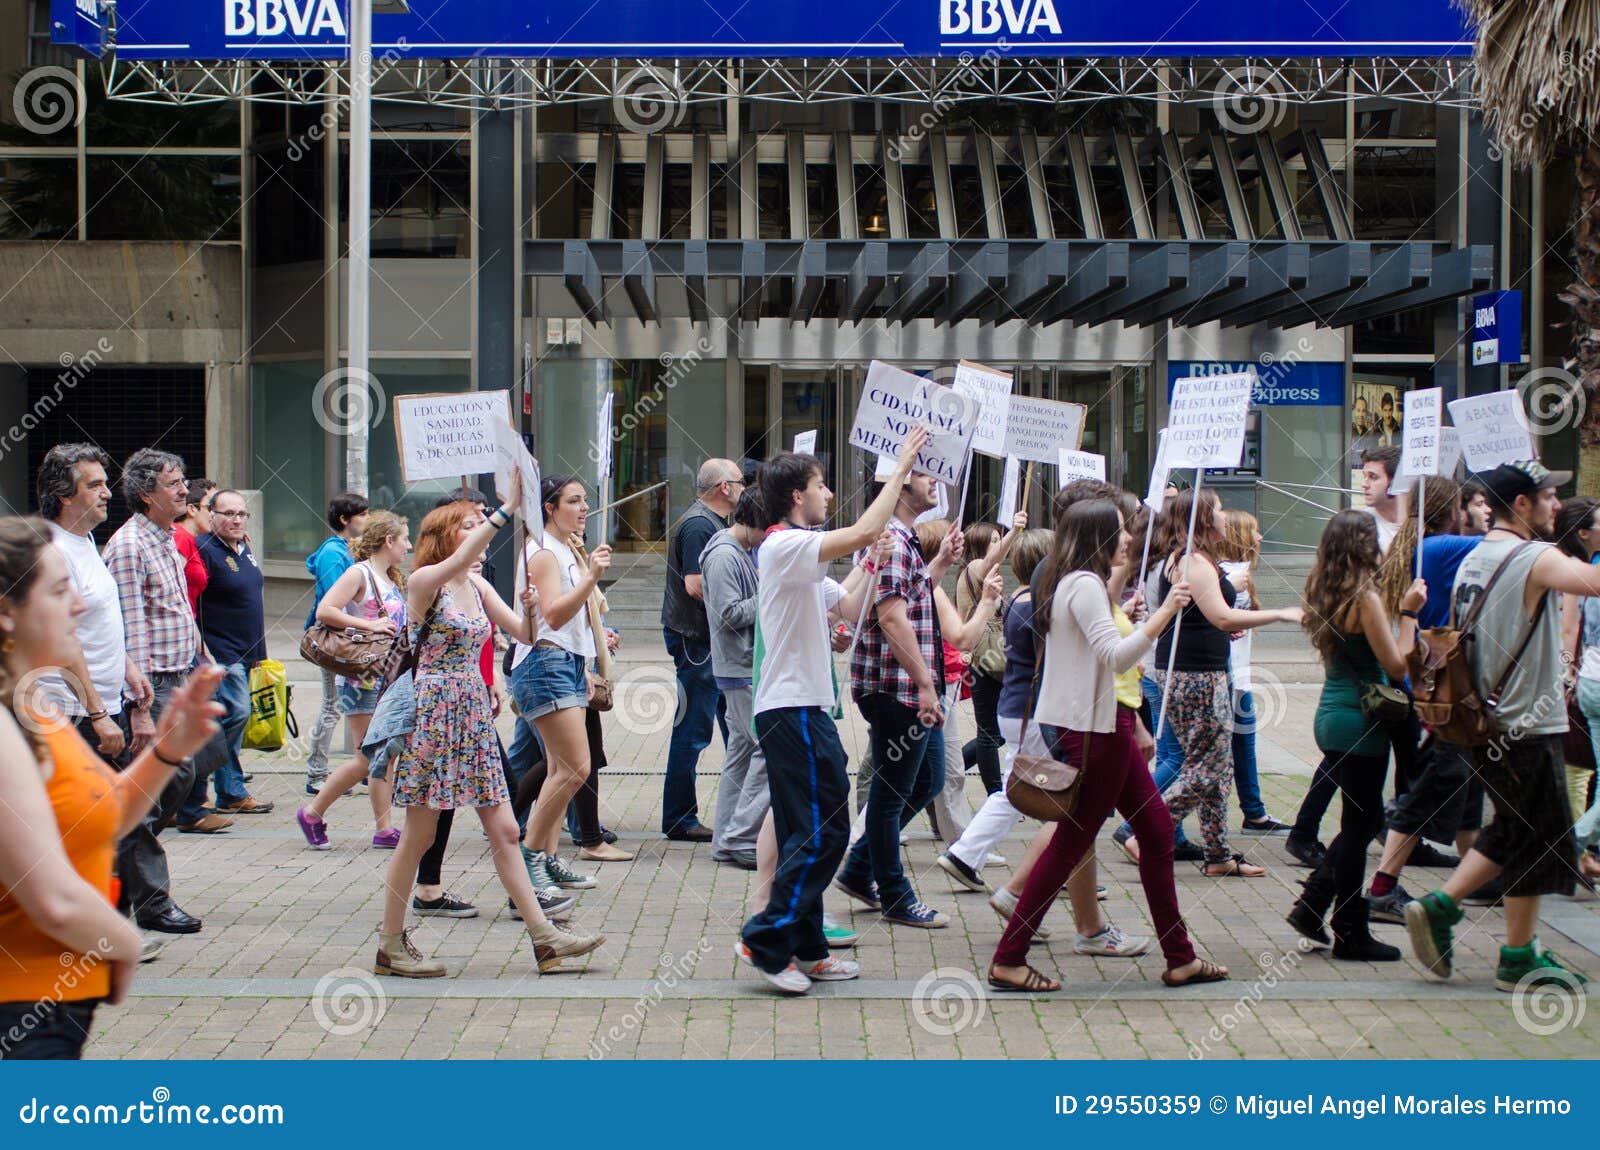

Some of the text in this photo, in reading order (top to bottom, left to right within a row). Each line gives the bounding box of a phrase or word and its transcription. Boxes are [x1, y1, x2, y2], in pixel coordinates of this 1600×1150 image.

[225, 0, 347, 36] BBVA
[940, 0, 1062, 34] BBVA
[1475, 306, 1495, 328] BBVA
[917, 385, 927, 399] A
[1250, 387, 1320, 403] express
[414, 400, 494, 417] EDUCACIÓN Y
[427, 416, 484, 430] SANIDAD:
[427, 430, 484, 445] PÚBLICAS
[416, 449, 426, 460] Y
[428, 448, 442, 459] DE
[854, 427, 953, 480] MERCNCÍA
